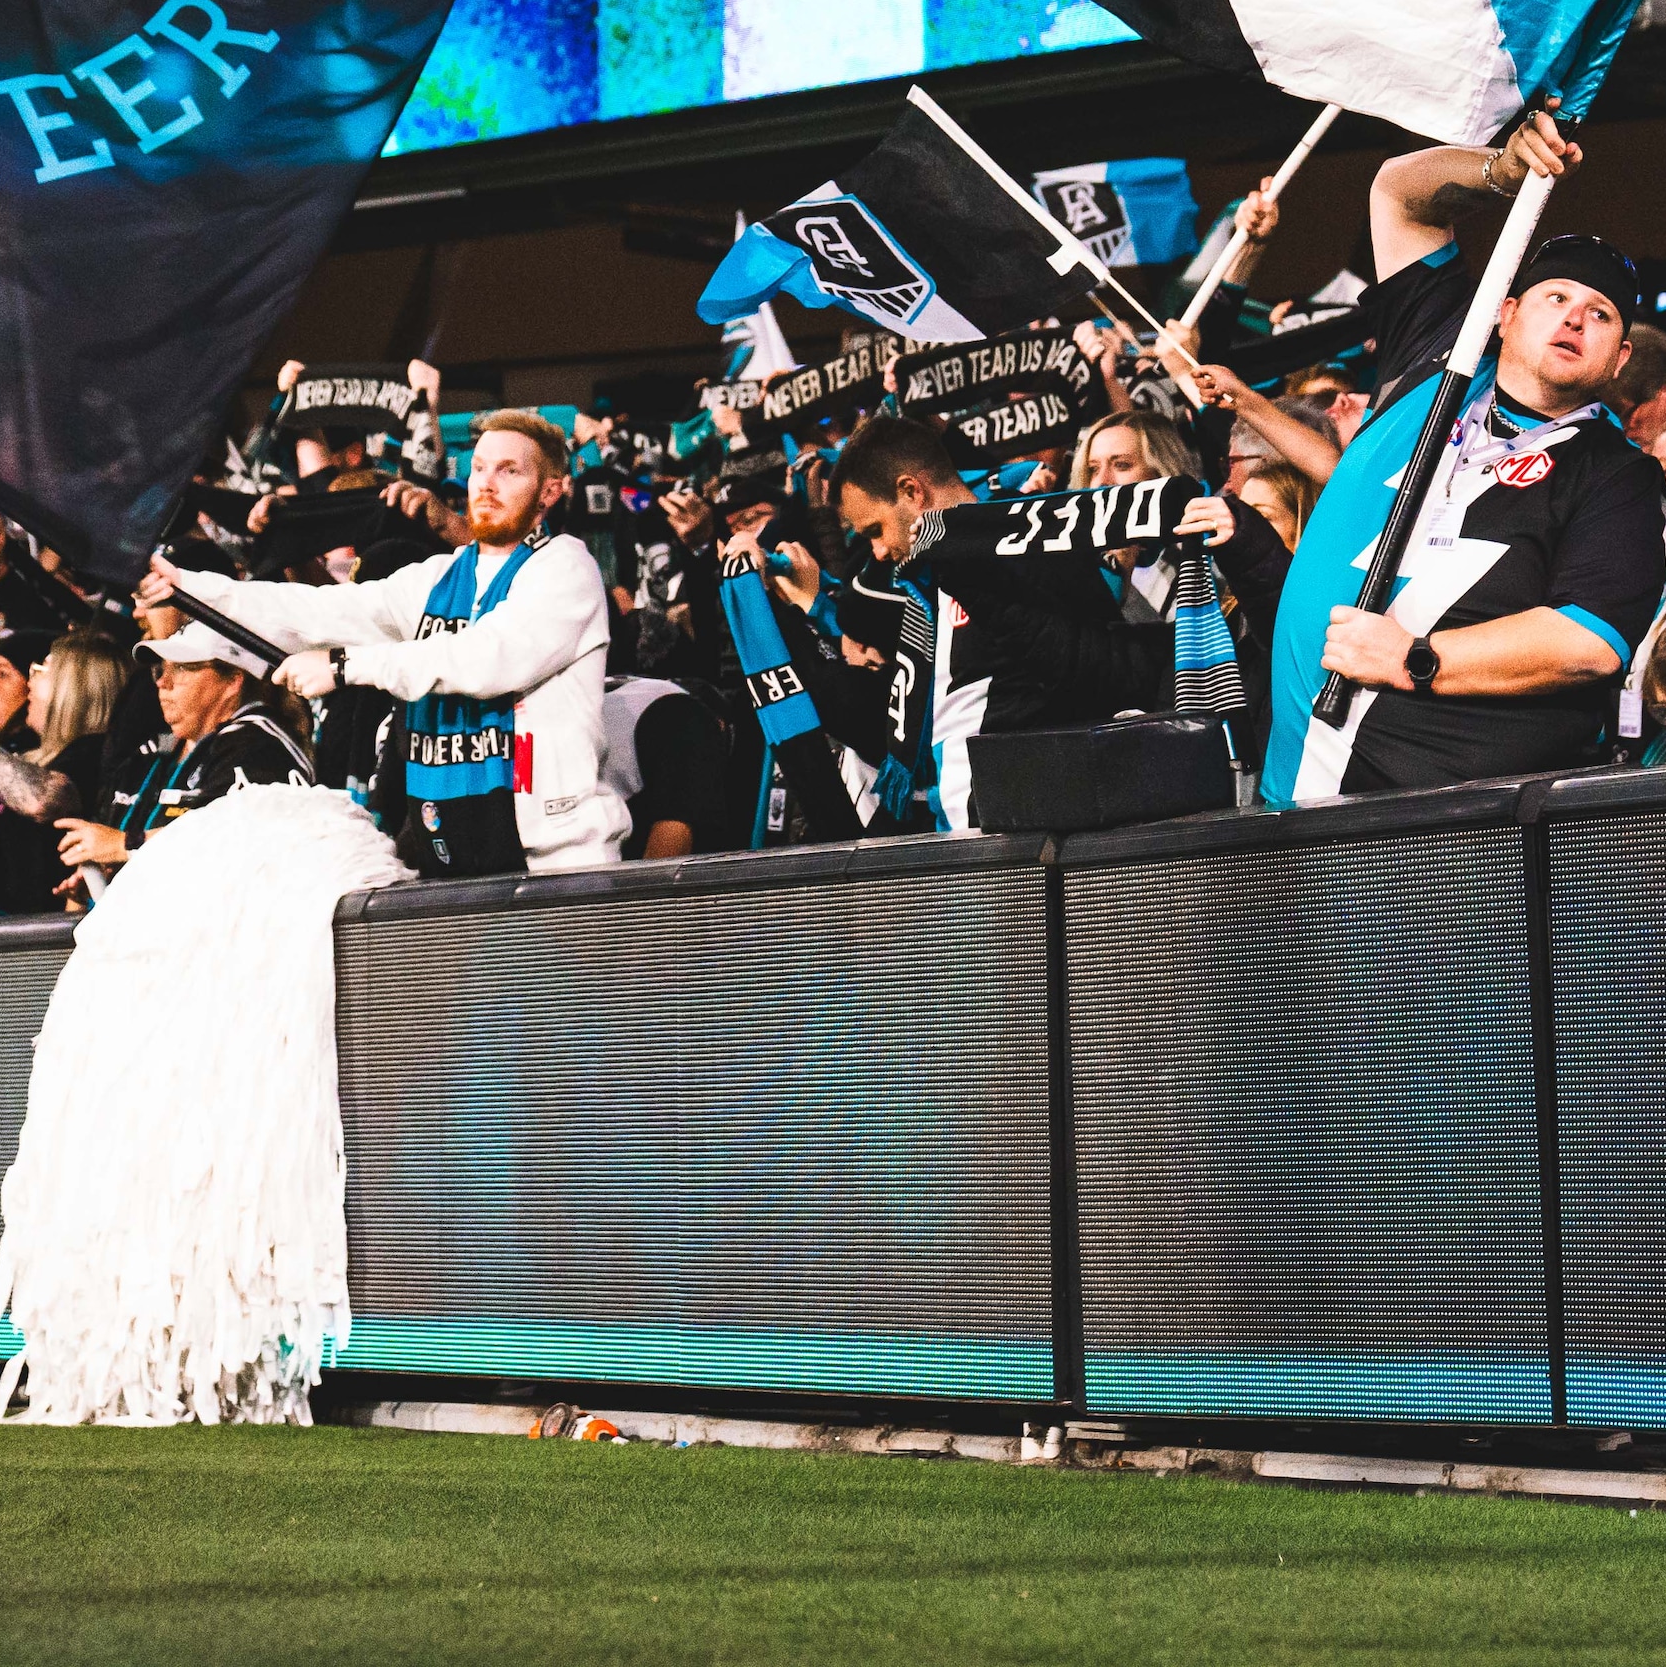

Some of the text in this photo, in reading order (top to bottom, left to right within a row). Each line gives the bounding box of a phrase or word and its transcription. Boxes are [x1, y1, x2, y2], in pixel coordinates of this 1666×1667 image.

[763, 372, 822, 420] NEVER
[824, 353, 871, 394] TEAR
[904, 356, 965, 404] NEVER
[969, 339, 1017, 378] TEAR
[1018, 337, 1044, 372] US
[989, 400, 1041, 442] TEAR
[1041, 394, 1069, 427] US
[1499, 452, 1549, 483] MG
